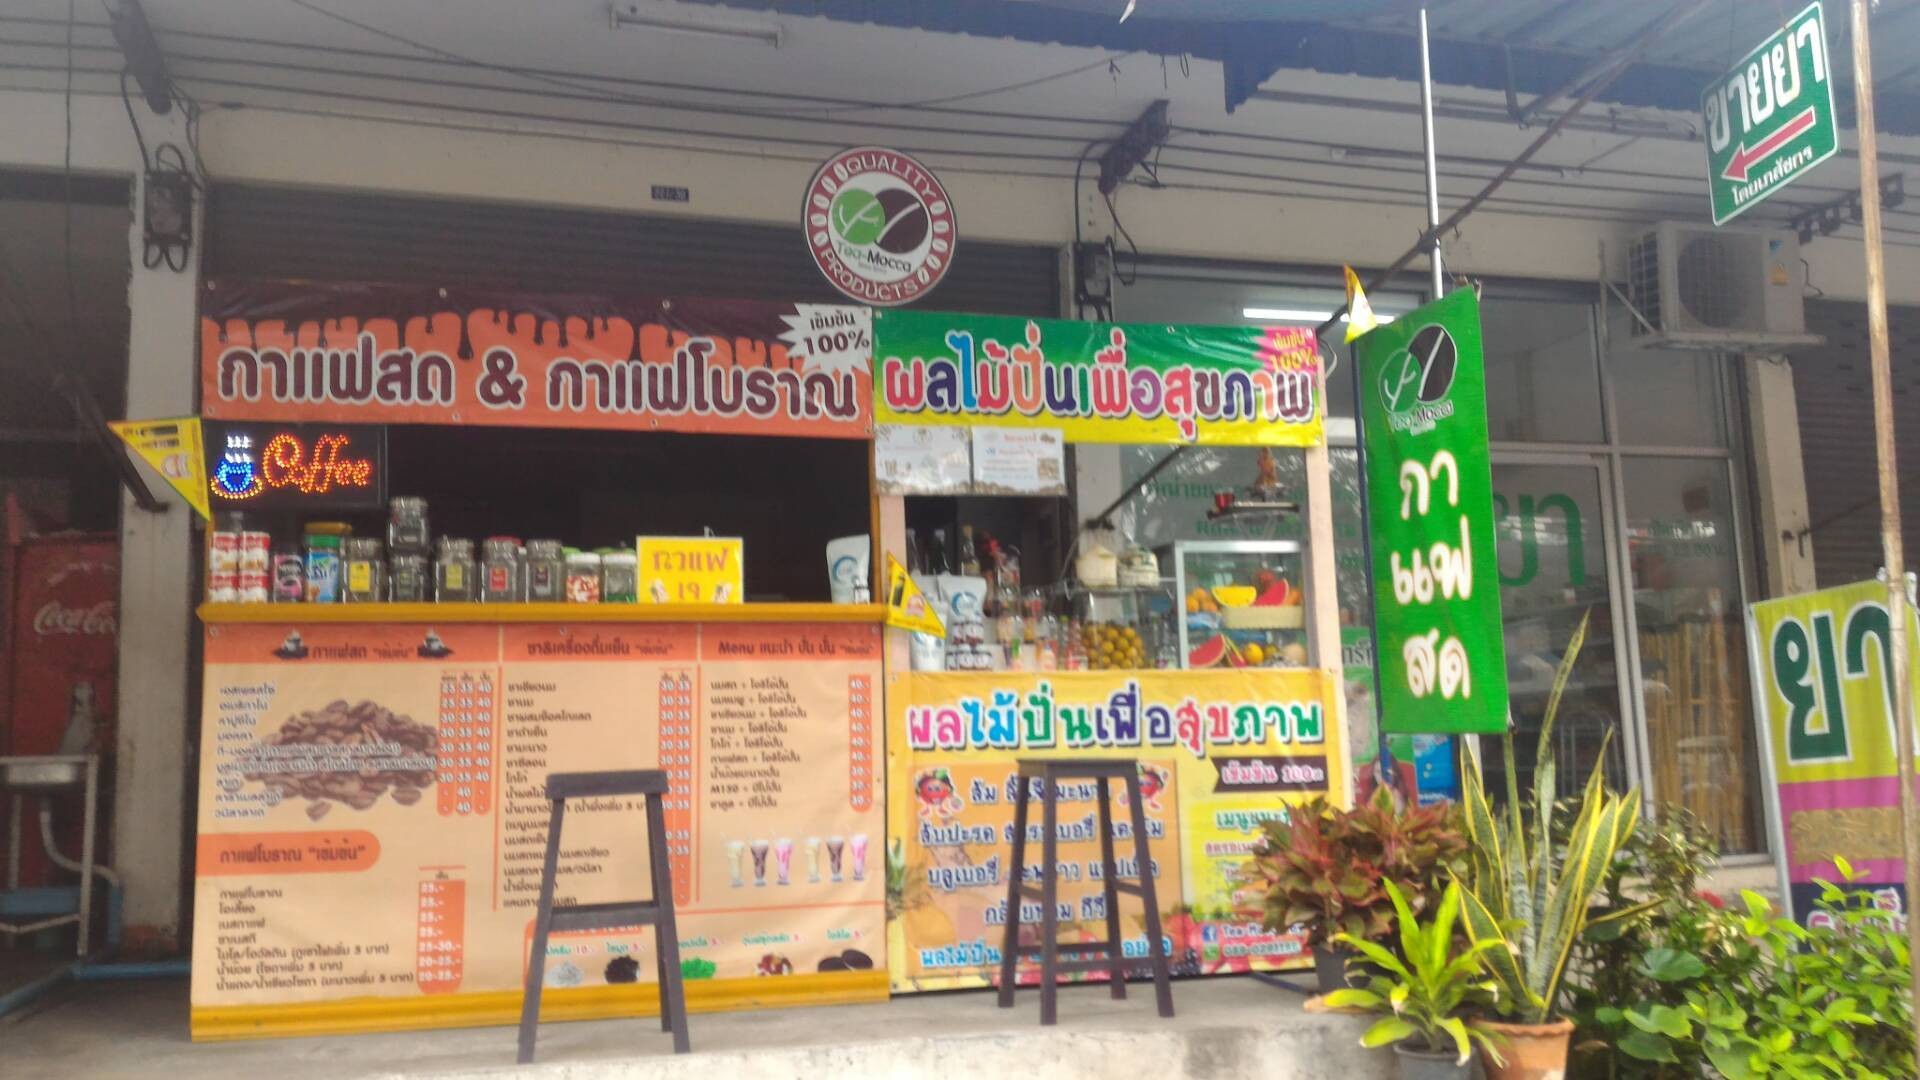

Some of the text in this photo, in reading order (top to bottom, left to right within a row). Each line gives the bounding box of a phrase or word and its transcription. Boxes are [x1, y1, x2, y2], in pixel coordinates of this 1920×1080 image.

[1706, 18, 1825, 154] ขายยา
[846, 154, 937, 197] QUALITY
[820, 249, 919, 300] PRODUCTS
[803, 329, 870, 356] 100%
[809, 309, 856, 331] เข้มข้น
[216, 332, 861, 421] กาแฟสด & กาแฟโบราณ
[884, 321, 1316, 439] ผลไม้ปั่นเพื่อสุขภาพ
[1269, 347, 1317, 371] 100%
[263, 434, 371, 493] Coffee
[907, 683, 1324, 756] ผลไม้ปั่นเพื่อสุขภาพ
